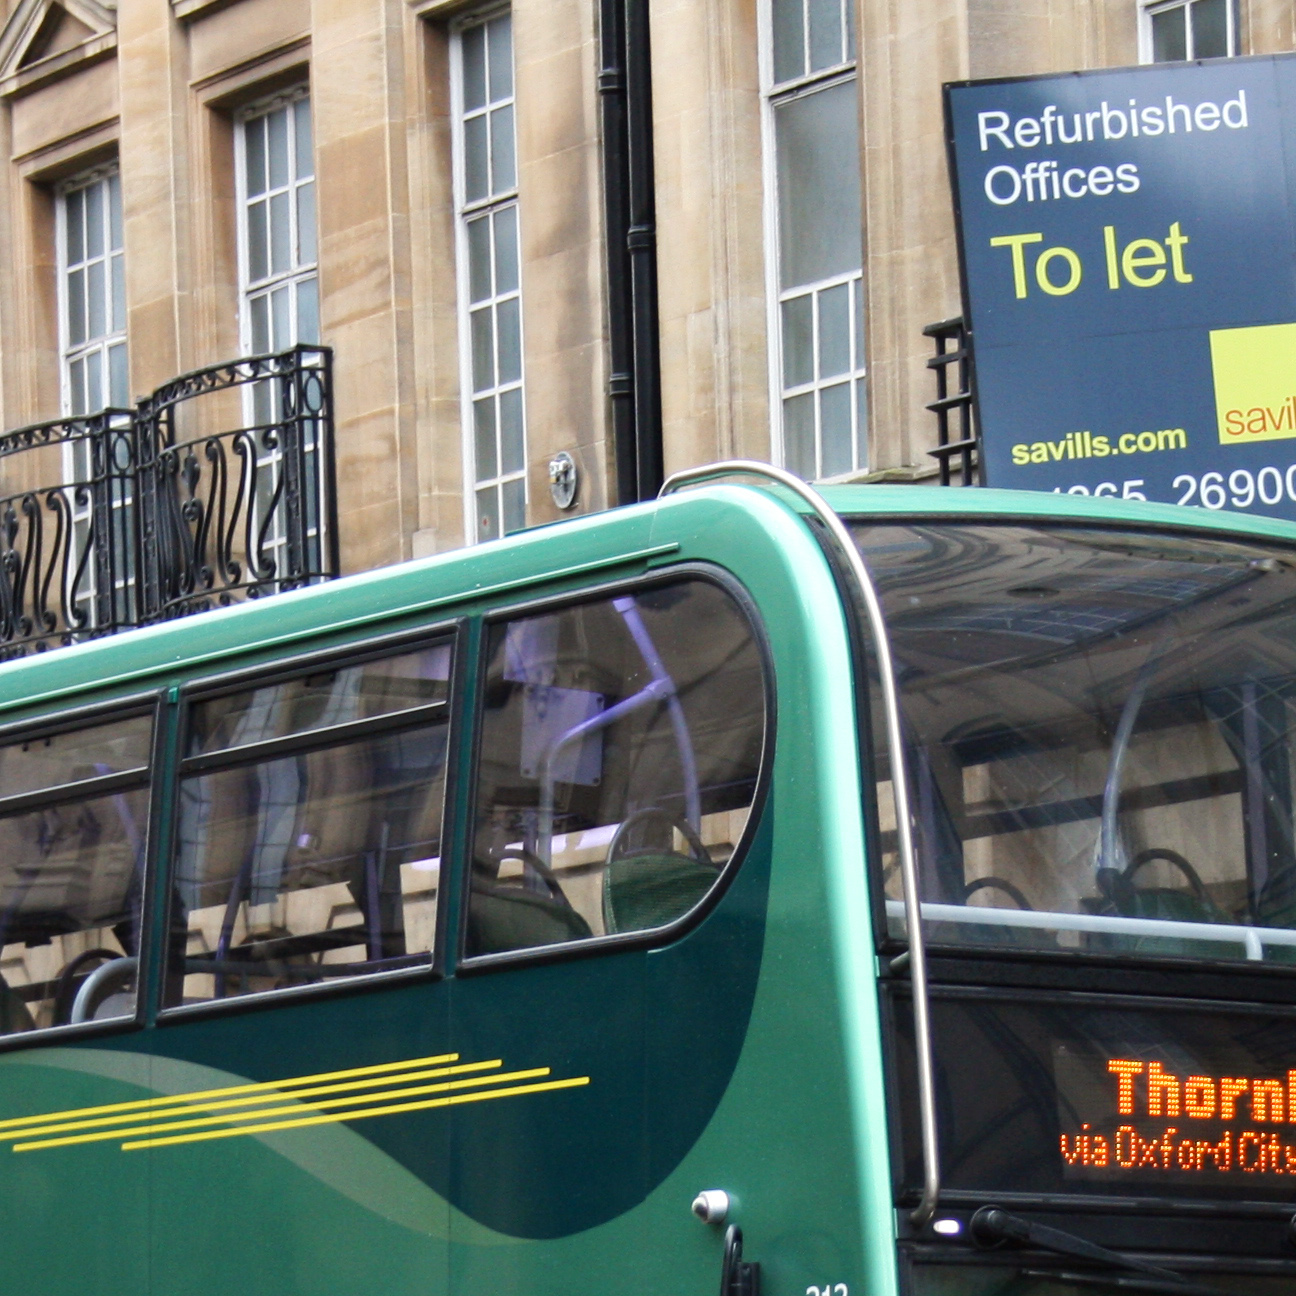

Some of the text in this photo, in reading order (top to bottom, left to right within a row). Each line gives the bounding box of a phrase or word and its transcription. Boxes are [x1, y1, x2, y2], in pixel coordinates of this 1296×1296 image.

[978, 90, 1248, 151] Refurbished
[984, 161, 1140, 205] Offices
[990, 222, 1193, 299] To let
[1011, 428, 1187, 465] savills.com
[1059, 1123, 1107, 1167] via
[1114, 1125, 1231, 1172] Oxford
